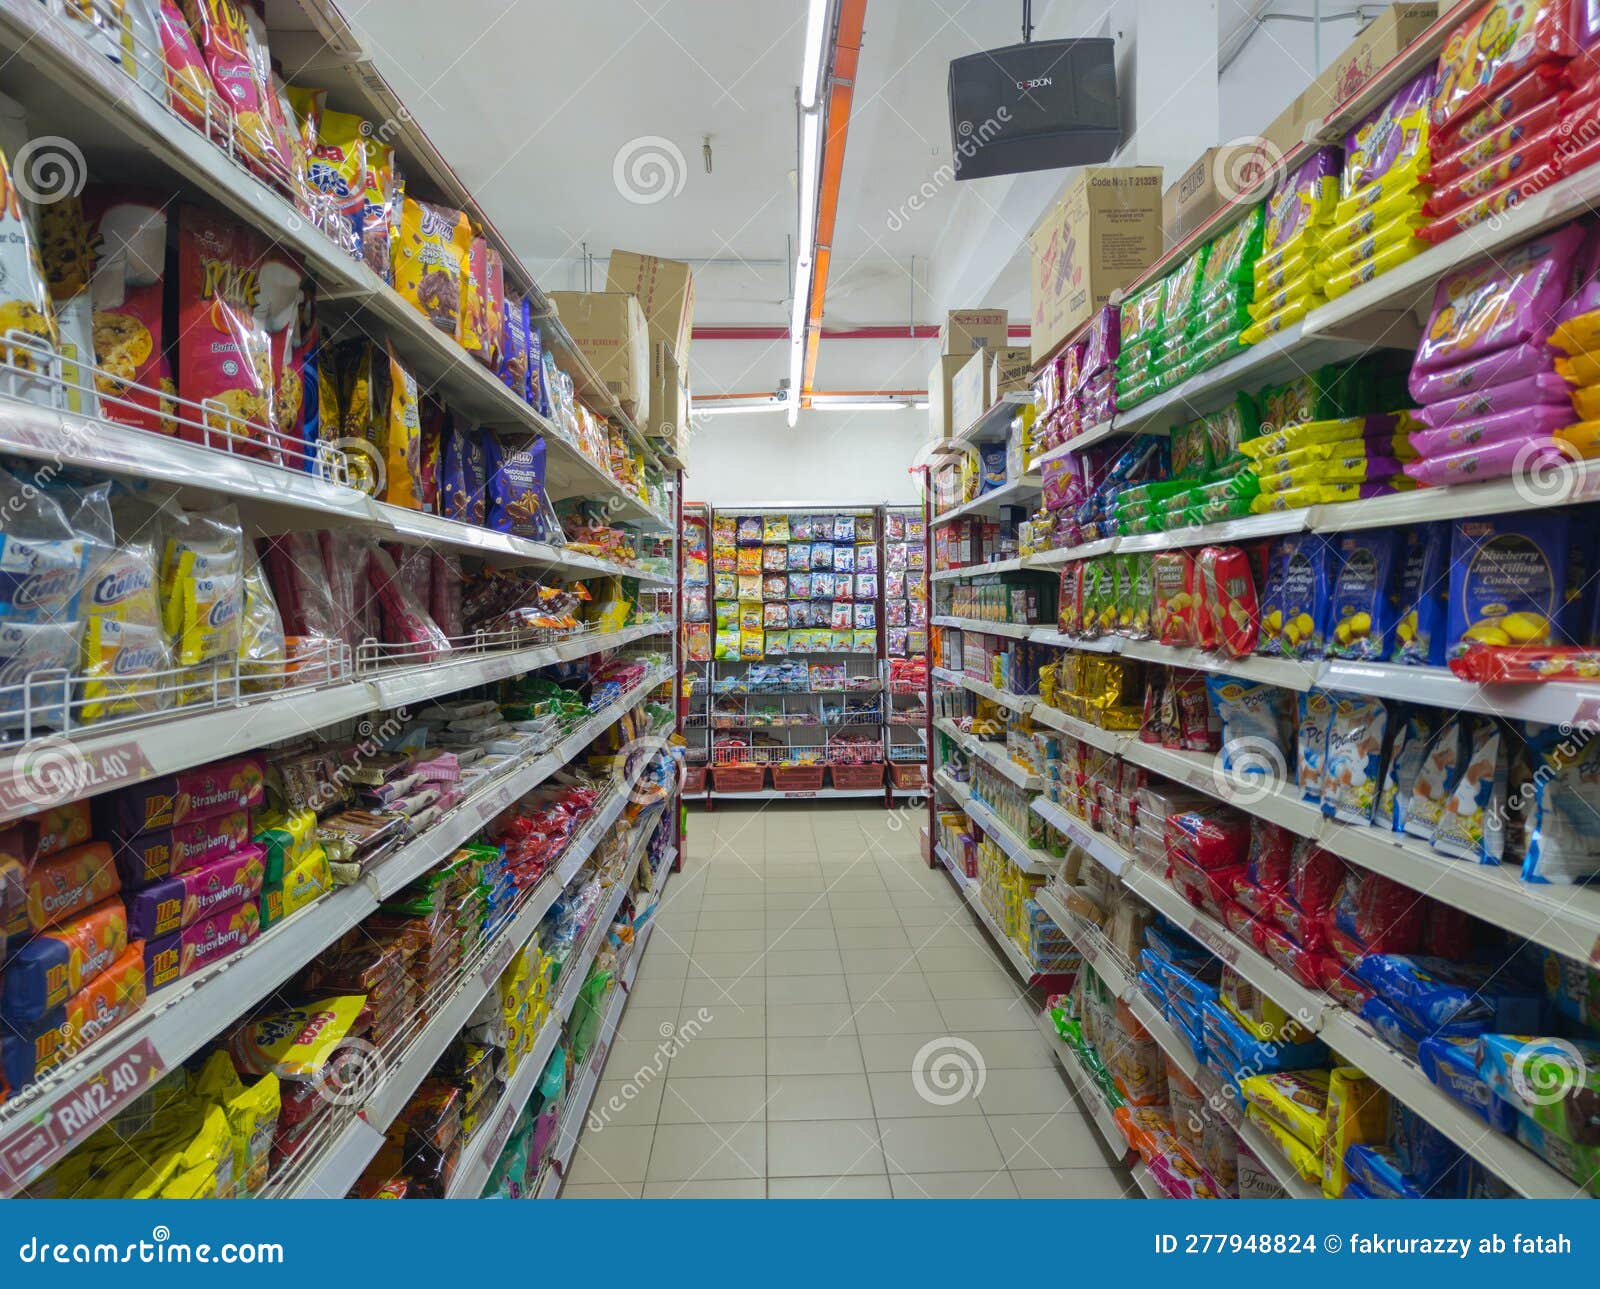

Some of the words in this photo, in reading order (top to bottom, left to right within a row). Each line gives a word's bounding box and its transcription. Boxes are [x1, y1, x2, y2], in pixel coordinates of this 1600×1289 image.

[1091, 177, 1111, 186] Code
[191, 789, 240, 809] Strawberry
[197, 883, 243, 909] Strawberry
[195, 928, 240, 957] Strawberry
[57, 1062, 138, 1136] RM2.40
